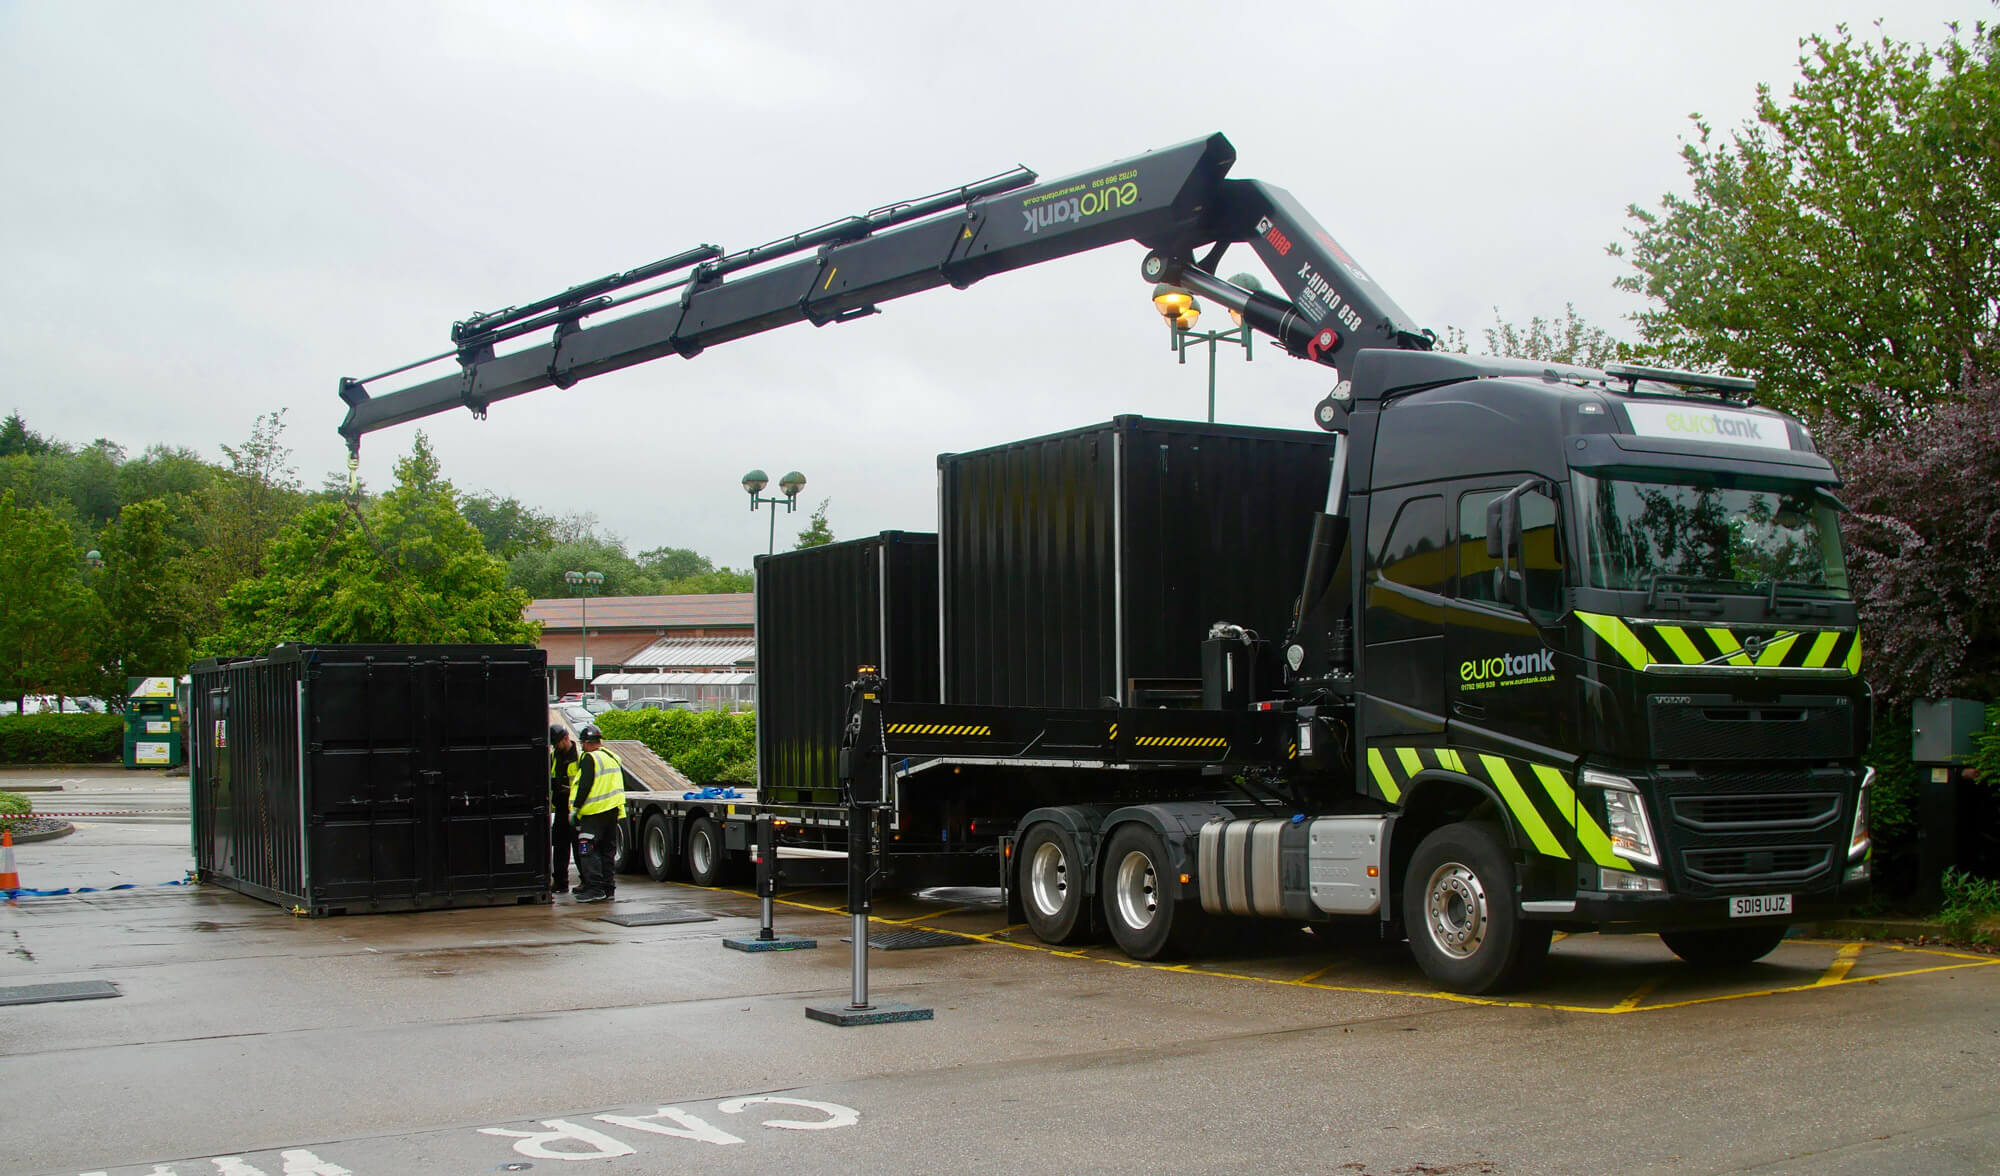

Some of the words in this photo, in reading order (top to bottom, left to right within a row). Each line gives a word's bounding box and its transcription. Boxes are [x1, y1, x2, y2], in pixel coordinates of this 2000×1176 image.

[1022, 184, 1087, 207] www.eurotank.co.uk
[1022, 182, 1138, 234] eurotank
[1265, 227, 1292, 257] HIAB
[1297, 261, 1342, 311] X-HIPRO
[1337, 303, 1363, 333] 858
[1665, 411, 1762, 440] eurotank
[1460, 648, 1556, 681] eurotank
[1500, 674, 1556, 687] www.eurotank.co.uk
[1655, 695, 1692, 705] VOLVO
[1736, 898, 1762, 914] SD19
[1764, 897, 1786, 912] UJZ
[476, 1096, 862, 1161] CAR
